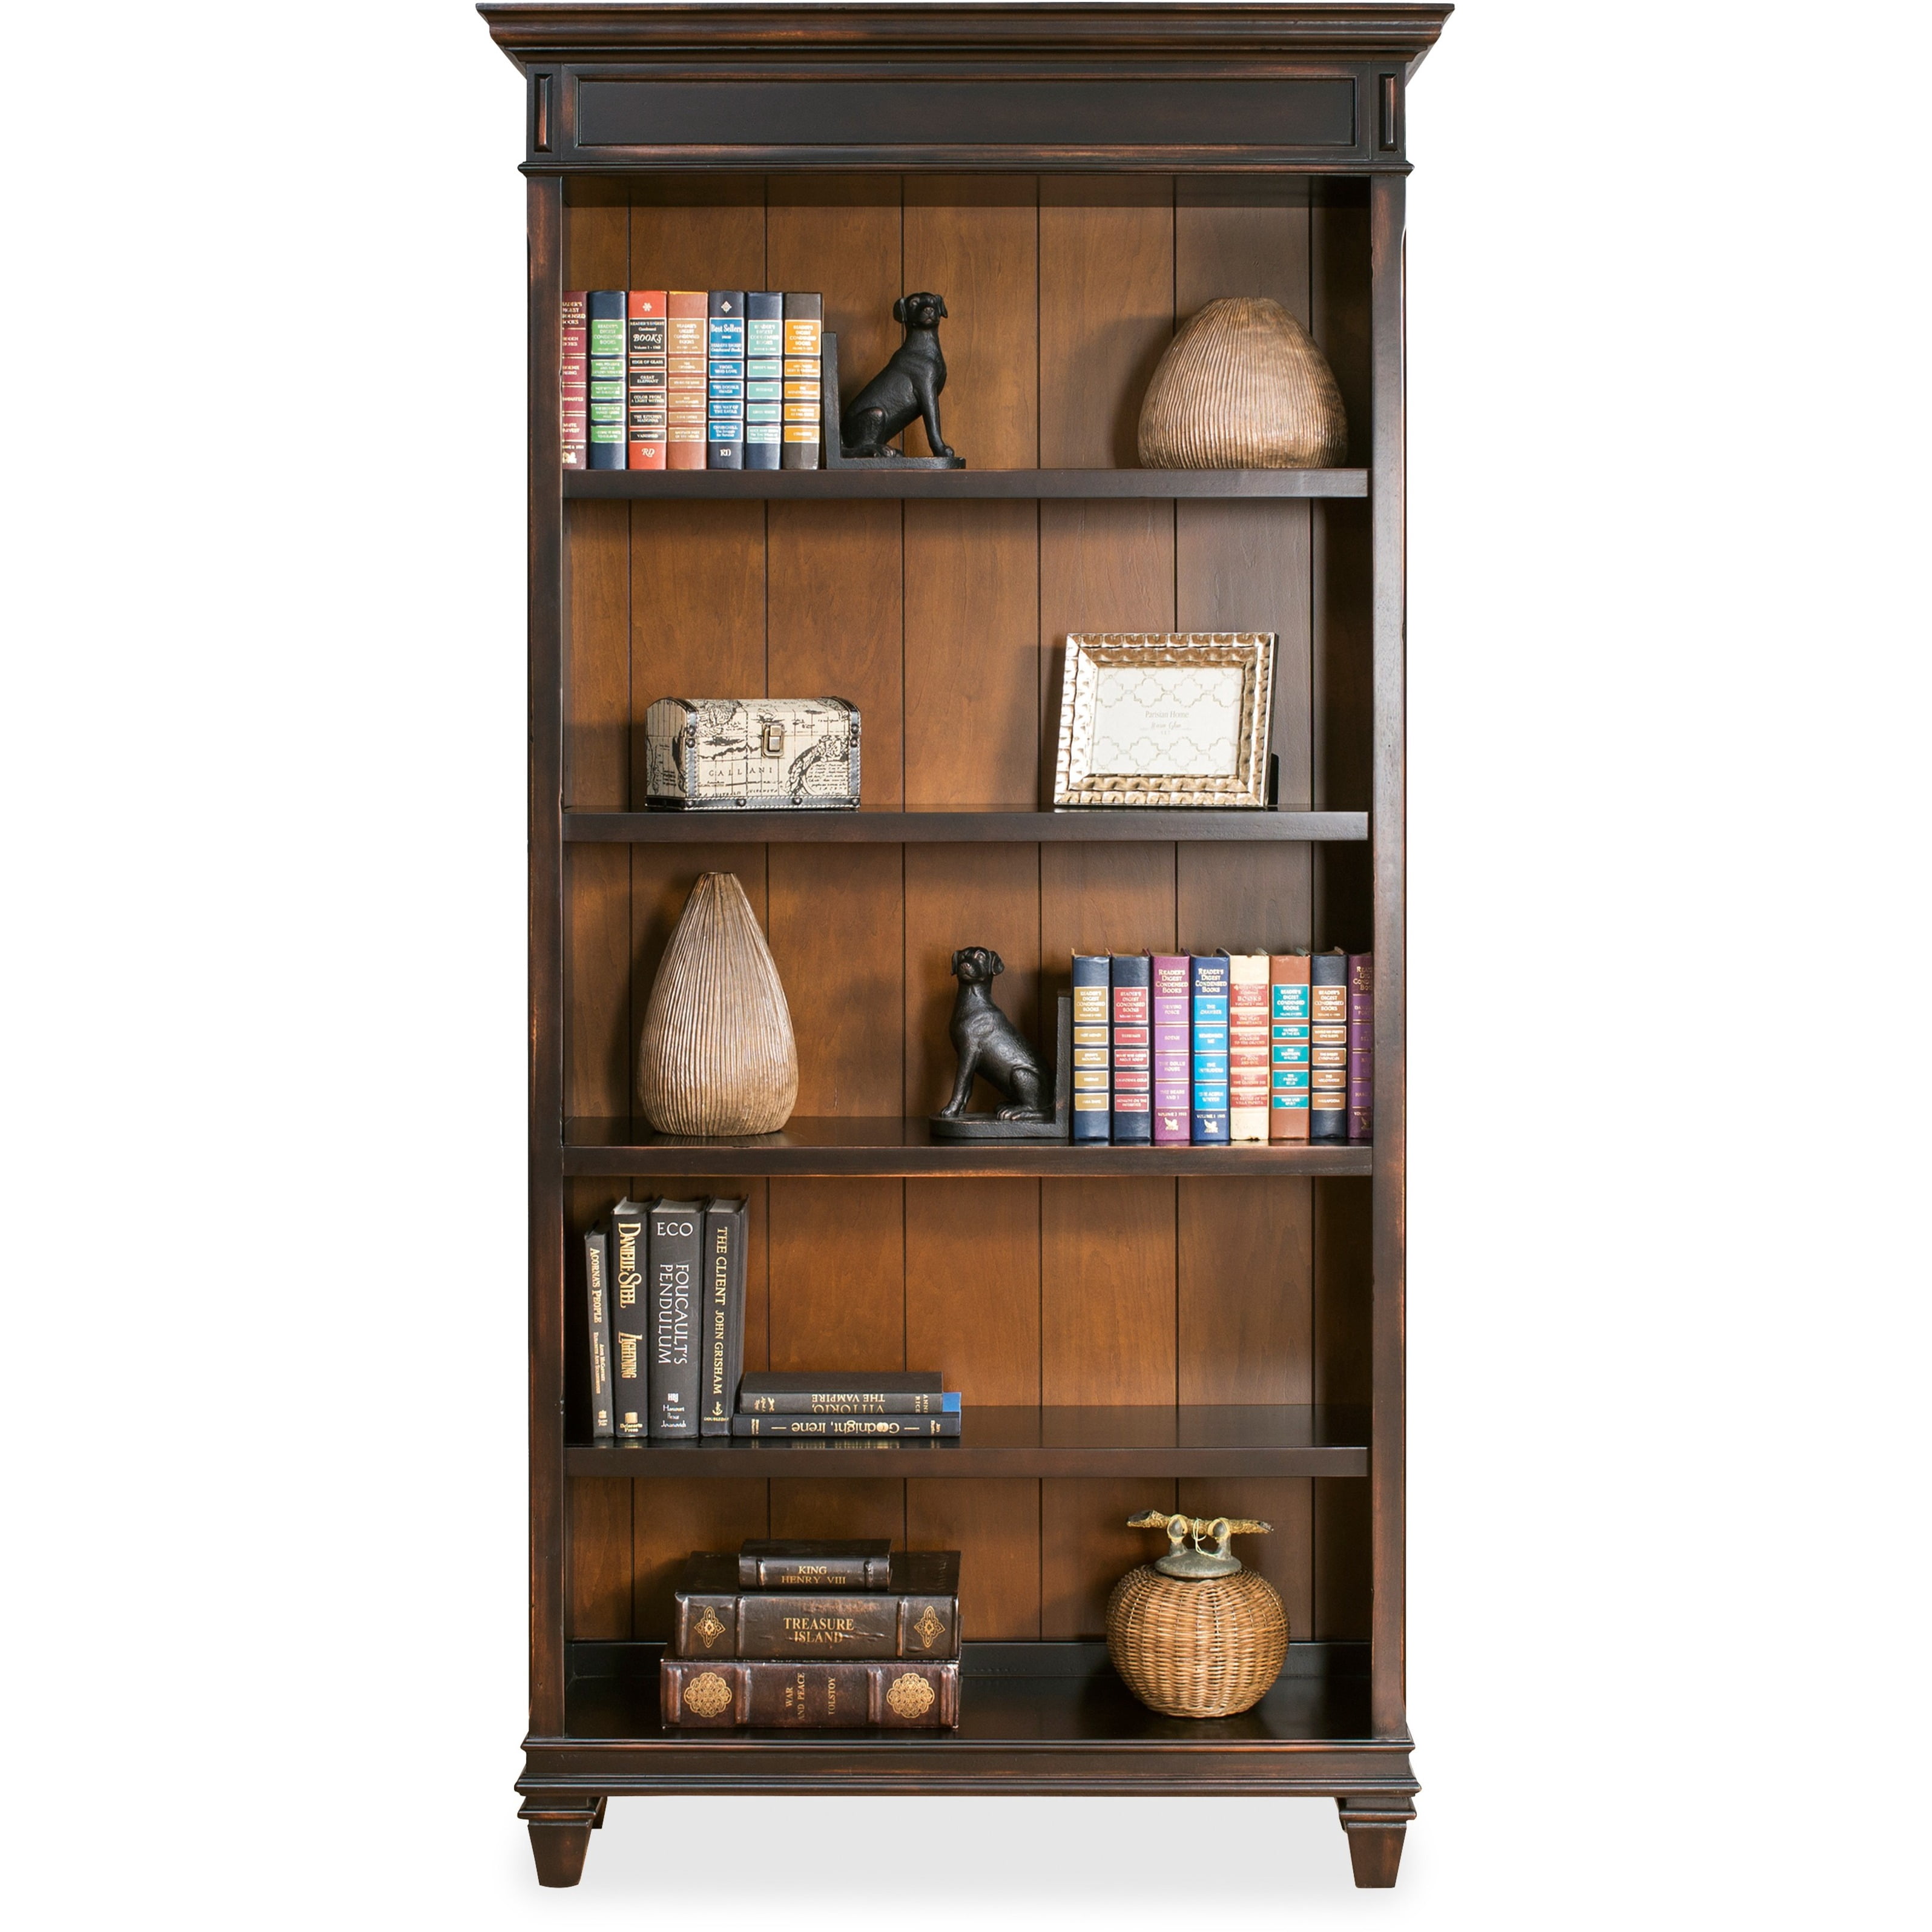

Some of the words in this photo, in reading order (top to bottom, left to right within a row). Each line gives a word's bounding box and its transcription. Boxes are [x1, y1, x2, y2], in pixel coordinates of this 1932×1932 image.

[711, 324, 723, 333] Best
[633, 334, 663, 344] BOOKS
[657, 1222, 693, 1236] ECO
[716, 1227, 727, 1253] THE
[618, 1222, 641, 1271] DANIELLE
[714, 1256, 727, 1305] CLIENT
[658, 1264, 673, 1363] PENDULUM
[673, 1264, 689, 1365] FOUCAULT'S
[713, 1342, 724, 1394] GRISHAM
[811, 1394, 860, 1403] VAMPIRE
[863, 1394, 886, 1402] THE
[791, 1422, 826, 1433] Irene
[799, 1566, 827, 1574] KING
[782, 1575, 820, 1584] HENRY
[783, 1618, 854, 1630] TREASURE
[794, 1631, 843, 1643] ISLAND
